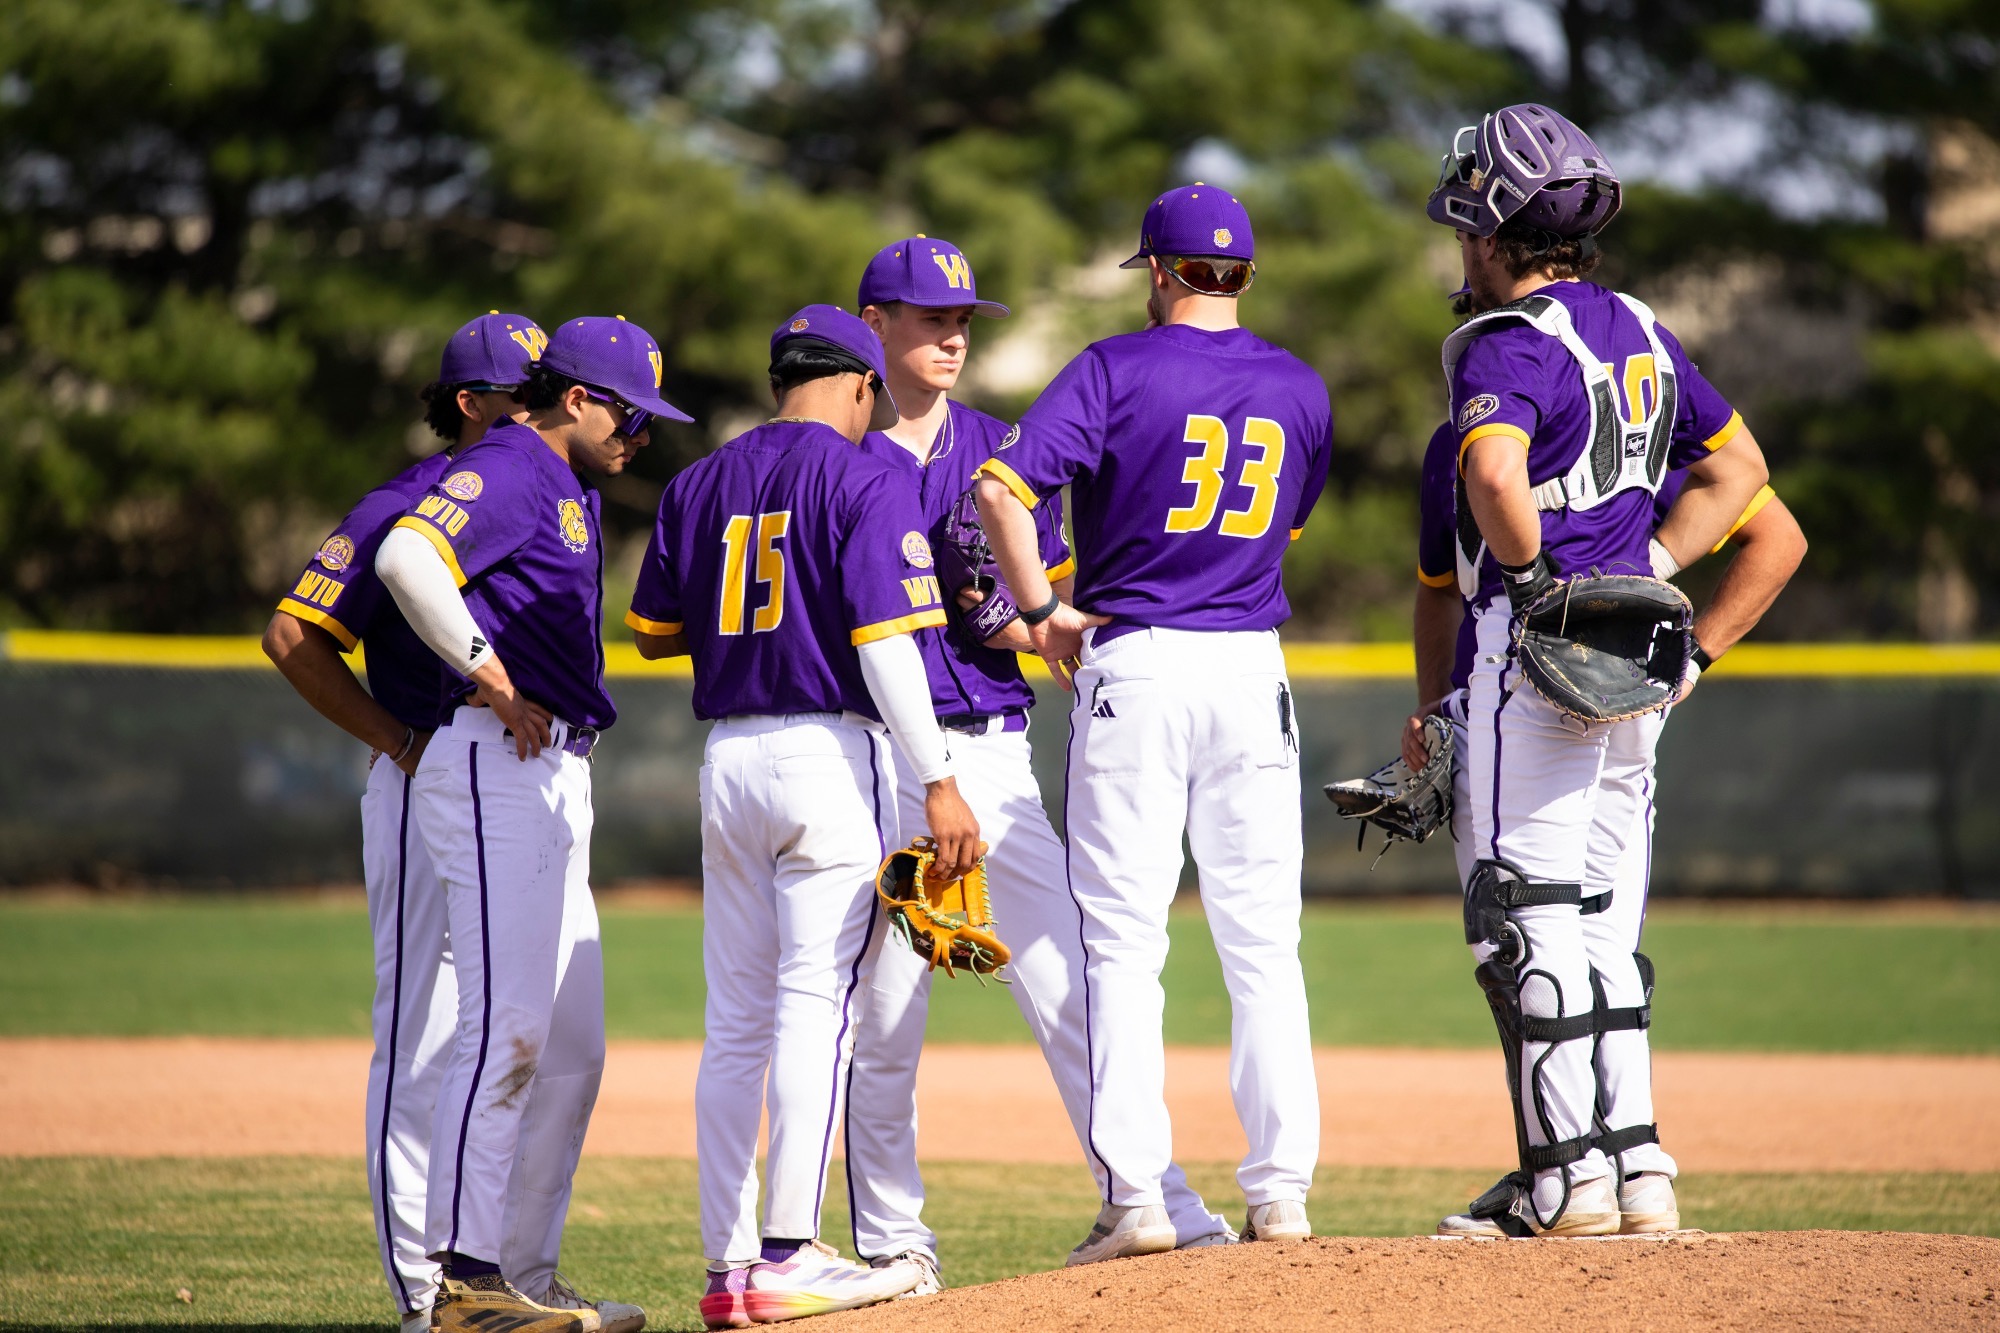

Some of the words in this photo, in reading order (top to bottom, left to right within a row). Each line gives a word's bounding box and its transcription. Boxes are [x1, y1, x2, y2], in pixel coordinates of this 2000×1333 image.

[1499, 173, 1527, 200] RAWLINGS
[933, 254, 971, 290] W
[509, 327, 549, 361] W
[1164, 413, 1286, 539] 33
[414, 495, 470, 537] WIU
[293, 569, 346, 607] WIU
[718, 510, 791, 635] 15
[899, 575, 942, 608] WI
[978, 600, 1004, 630] Rawlings
